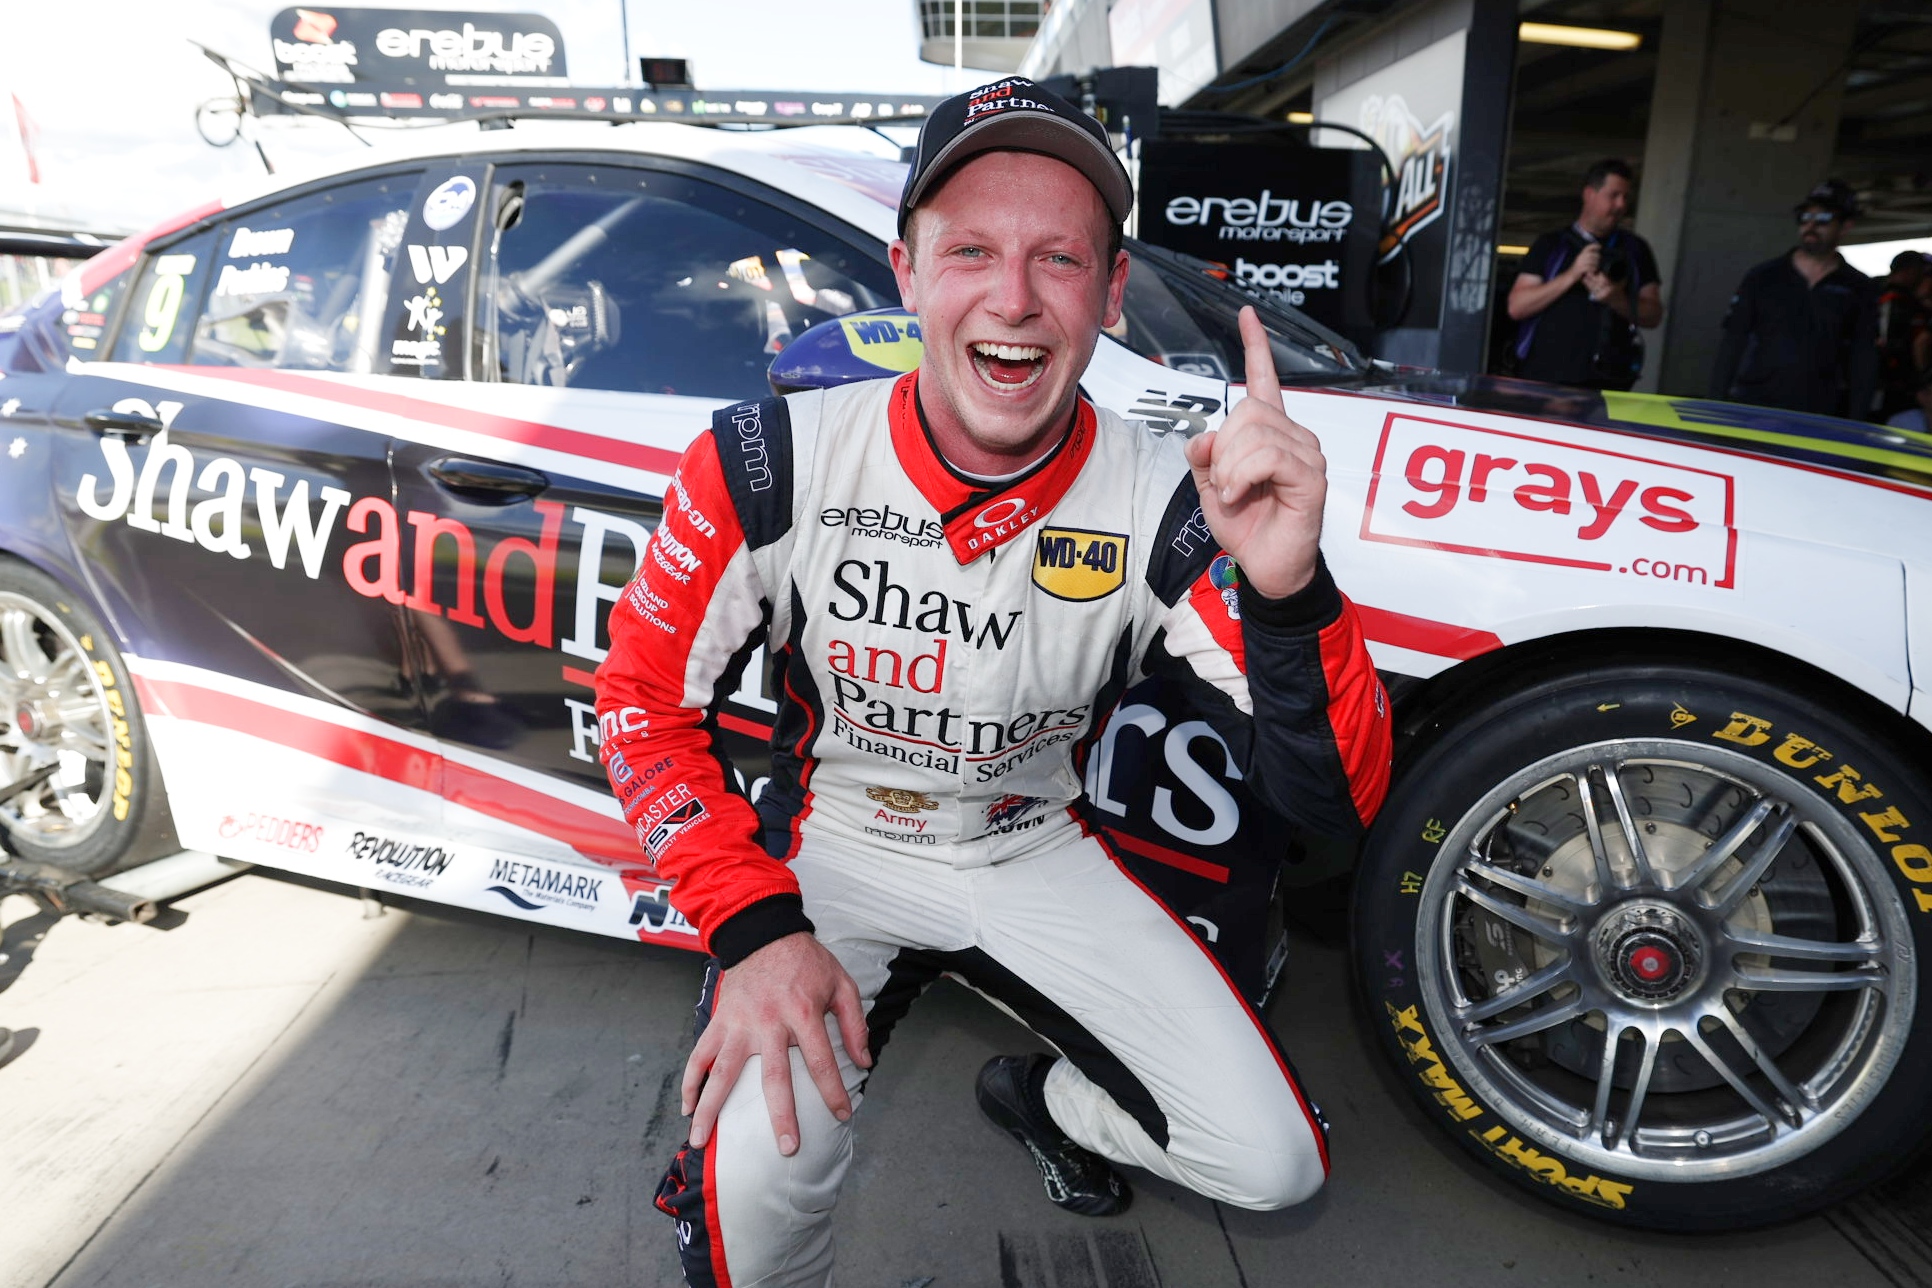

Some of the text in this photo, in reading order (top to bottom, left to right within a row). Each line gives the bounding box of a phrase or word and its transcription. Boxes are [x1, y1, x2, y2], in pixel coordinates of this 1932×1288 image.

[969, 86, 1013, 107] and
[1165, 190, 1353, 227] erebus
[1219, 225, 1347, 245] motorsport
[1235, 257, 1339, 289] boost
[139, 273, 185, 352] 9
[850, 320, 923, 346] WD-4
[1401, 444, 1700, 540] grays
[820, 504, 945, 539] erebus
[851, 528, 944, 549] motorsport
[966, 506, 1040, 550] OAKLEY
[1171, 506, 1212, 558] rp
[1618, 557, 1708, 586] .com
[629, 593, 677, 635] SOLUTIONS
[634, 586, 659, 613] GROUP
[827, 559, 1023, 651] Shaw
[827, 638, 948, 695] and
[828, 670, 1091, 756] Partners
[833, 713, 1074, 783] Financial Services
[624, 756, 675, 798] GALORE
[247, 813, 325, 853] PEDDERS
[874, 808, 928, 833] Army
[346, 831, 455, 876] REVOLUTION
[489, 858, 603, 902] METAMARK
[565, 897, 596, 911] Company
